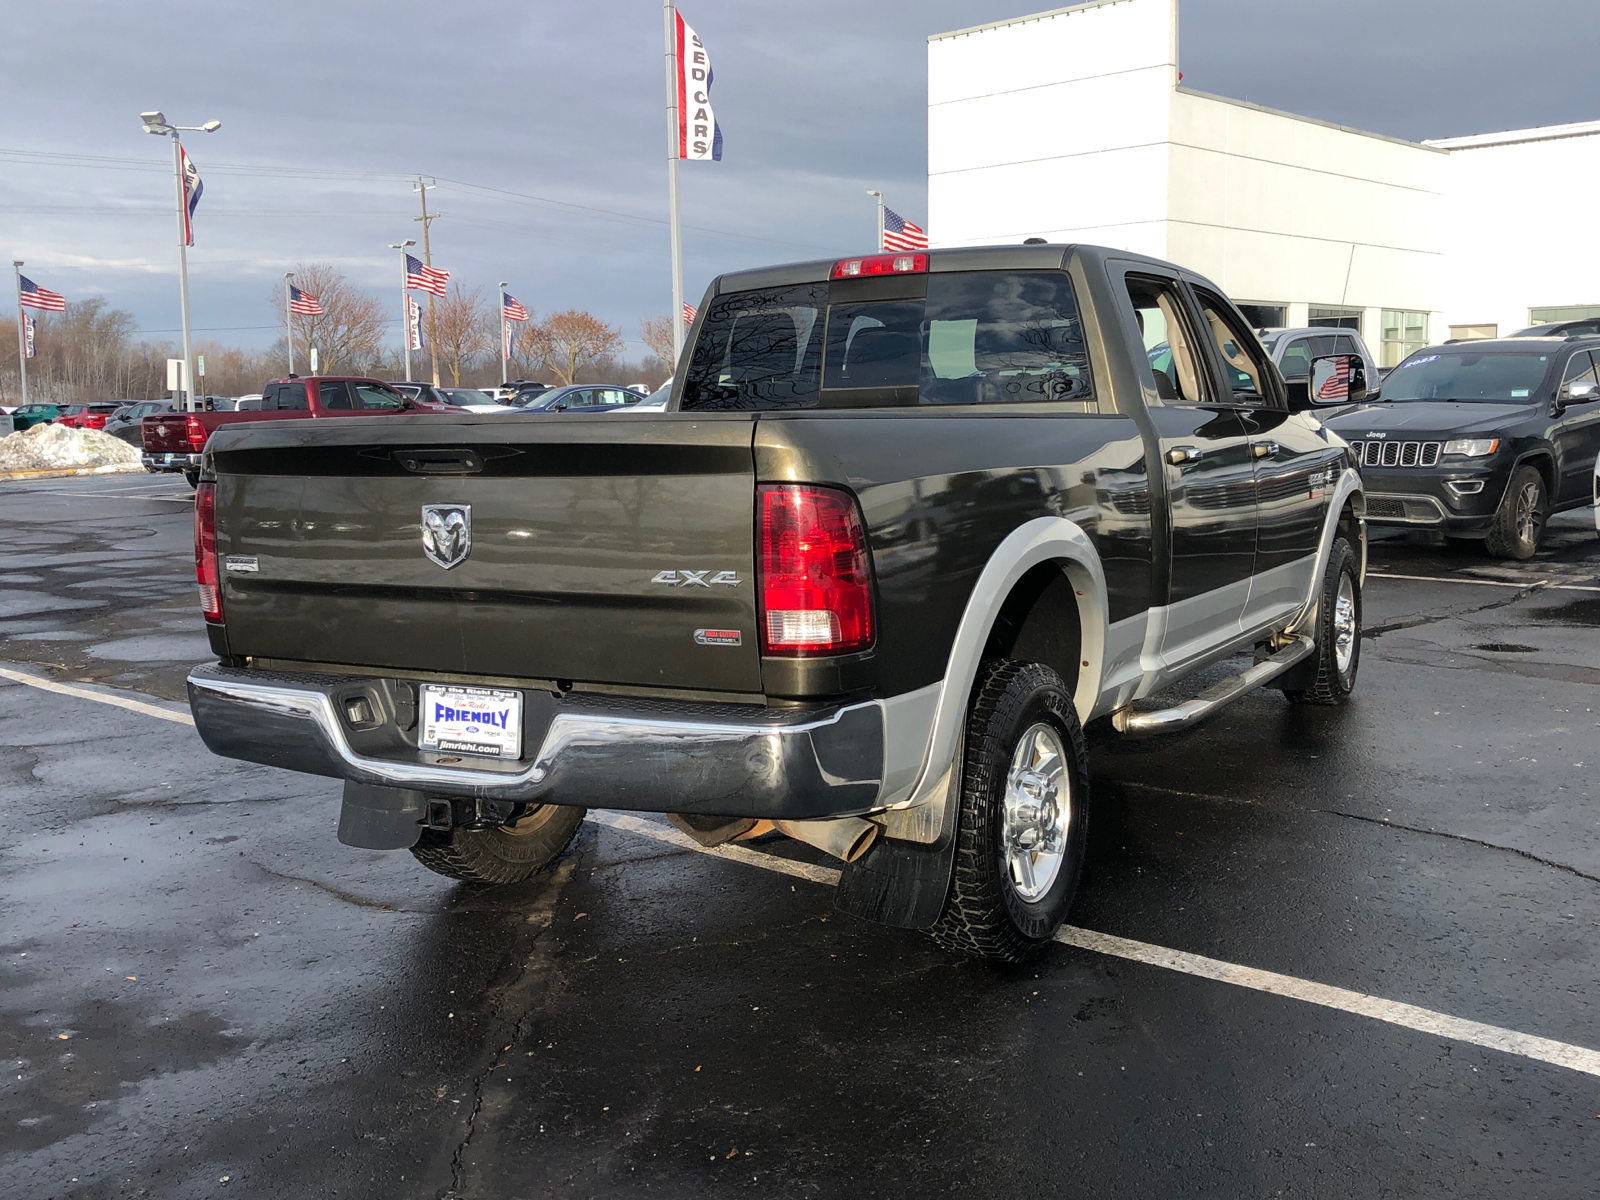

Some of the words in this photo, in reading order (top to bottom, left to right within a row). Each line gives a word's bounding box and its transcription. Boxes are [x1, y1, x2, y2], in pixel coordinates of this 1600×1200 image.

[692, 35, 706, 81] SED
[693, 91, 709, 154] CARS
[1366, 431, 1386, 439] Jeep
[435, 702, 509, 730] FRIENDLY
[468, 701, 490, 710] Riehl's
[439, 740, 499, 754] jimriehl.com
